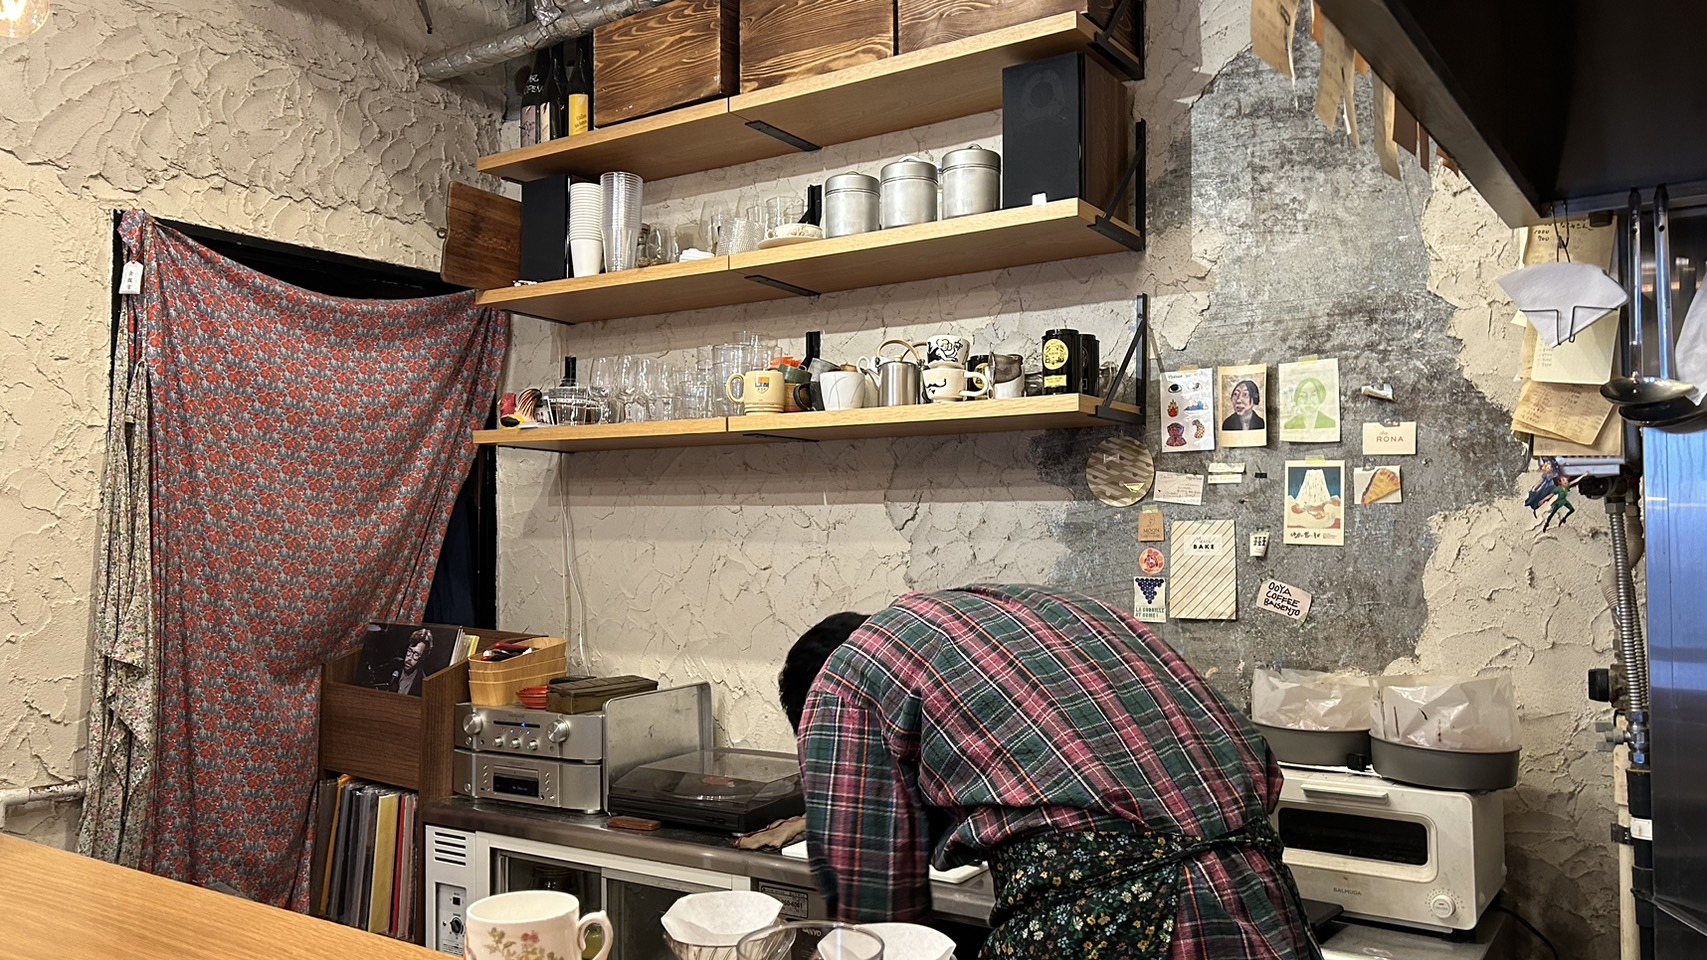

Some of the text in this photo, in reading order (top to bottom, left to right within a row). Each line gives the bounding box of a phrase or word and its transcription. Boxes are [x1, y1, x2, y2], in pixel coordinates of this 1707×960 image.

[1263, 598, 1301, 616] BAISENJO
[1265, 590, 1301, 608] COFFEE
[1333, 887, 1362, 896] BALMUDA
